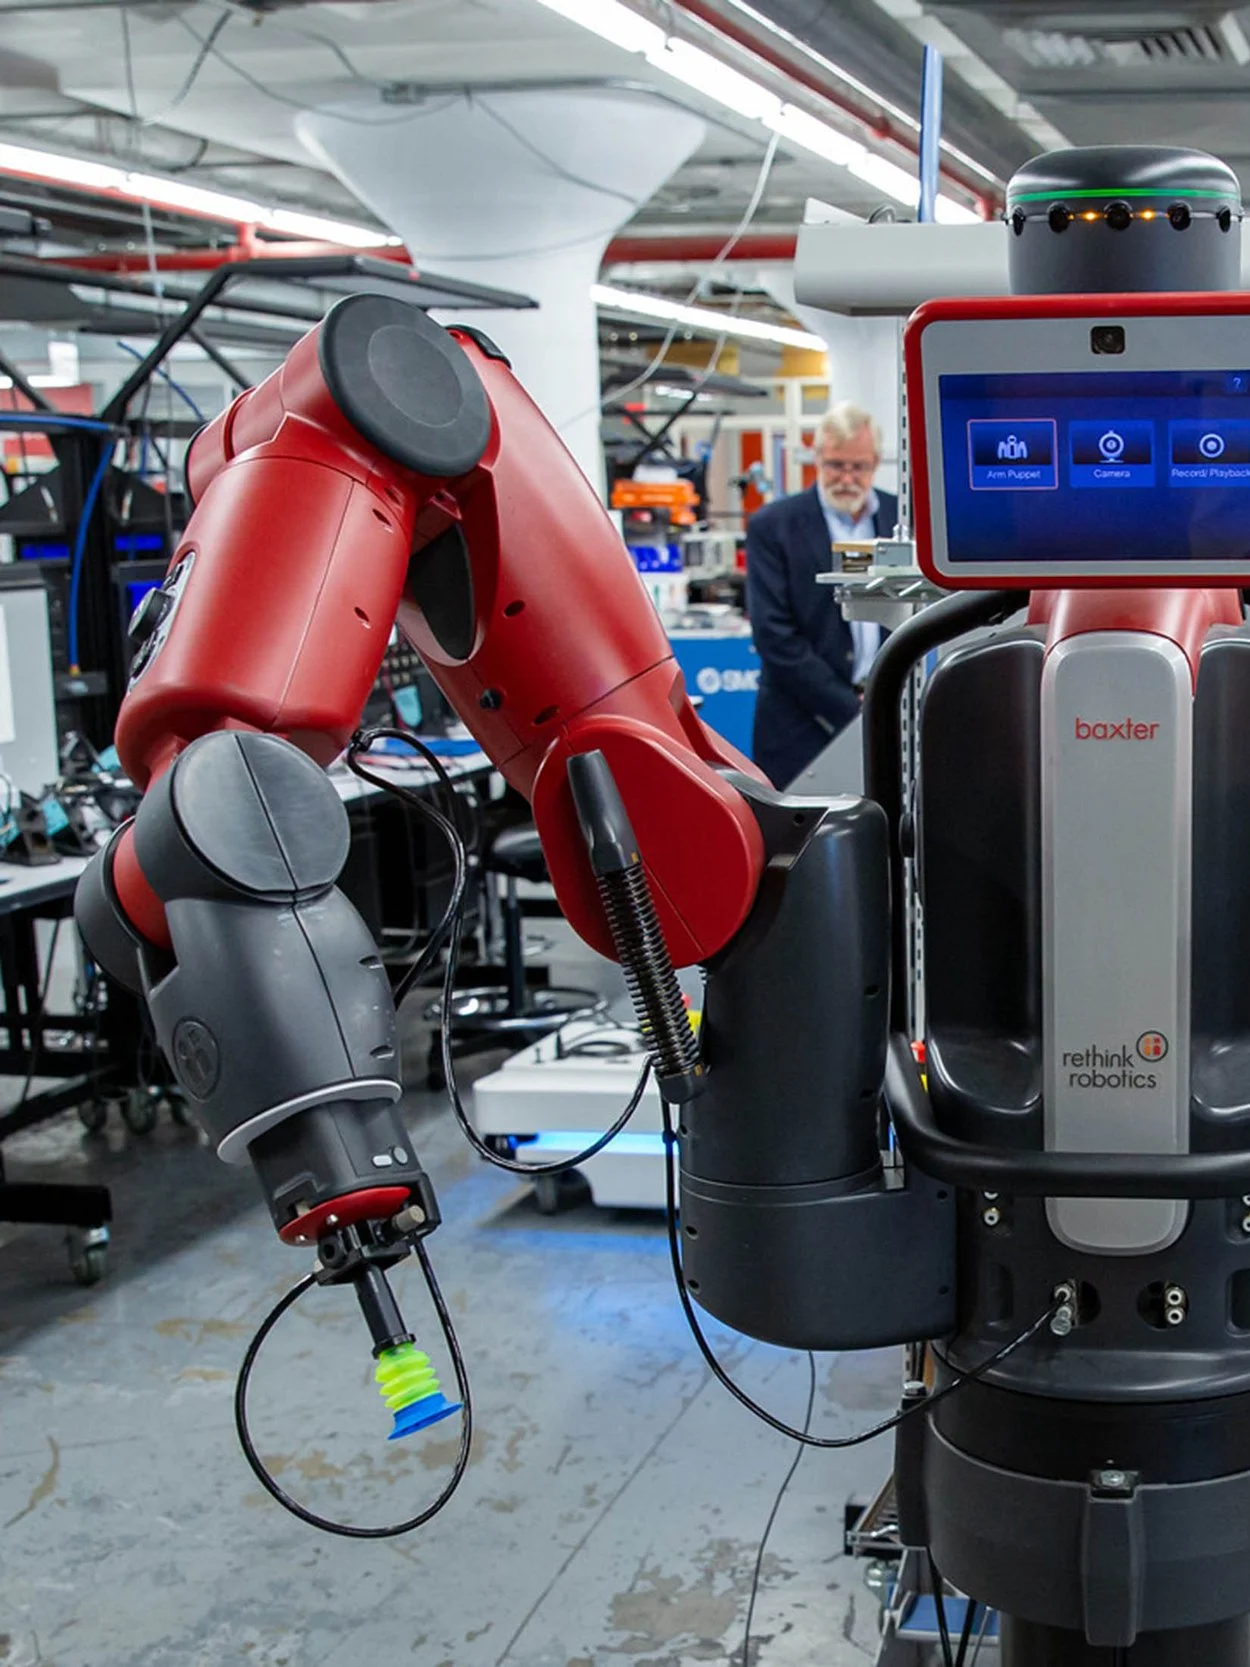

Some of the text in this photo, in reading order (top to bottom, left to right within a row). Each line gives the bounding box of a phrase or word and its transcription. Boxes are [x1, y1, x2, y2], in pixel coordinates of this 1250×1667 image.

[986, 468, 1041, 481] Arm Puppet
[1092, 468, 1131, 479] Camera
[1075, 717, 1160, 740] baxter
[1062, 1044, 1135, 1068] rethink
[1069, 1069, 1157, 1089] robotics
